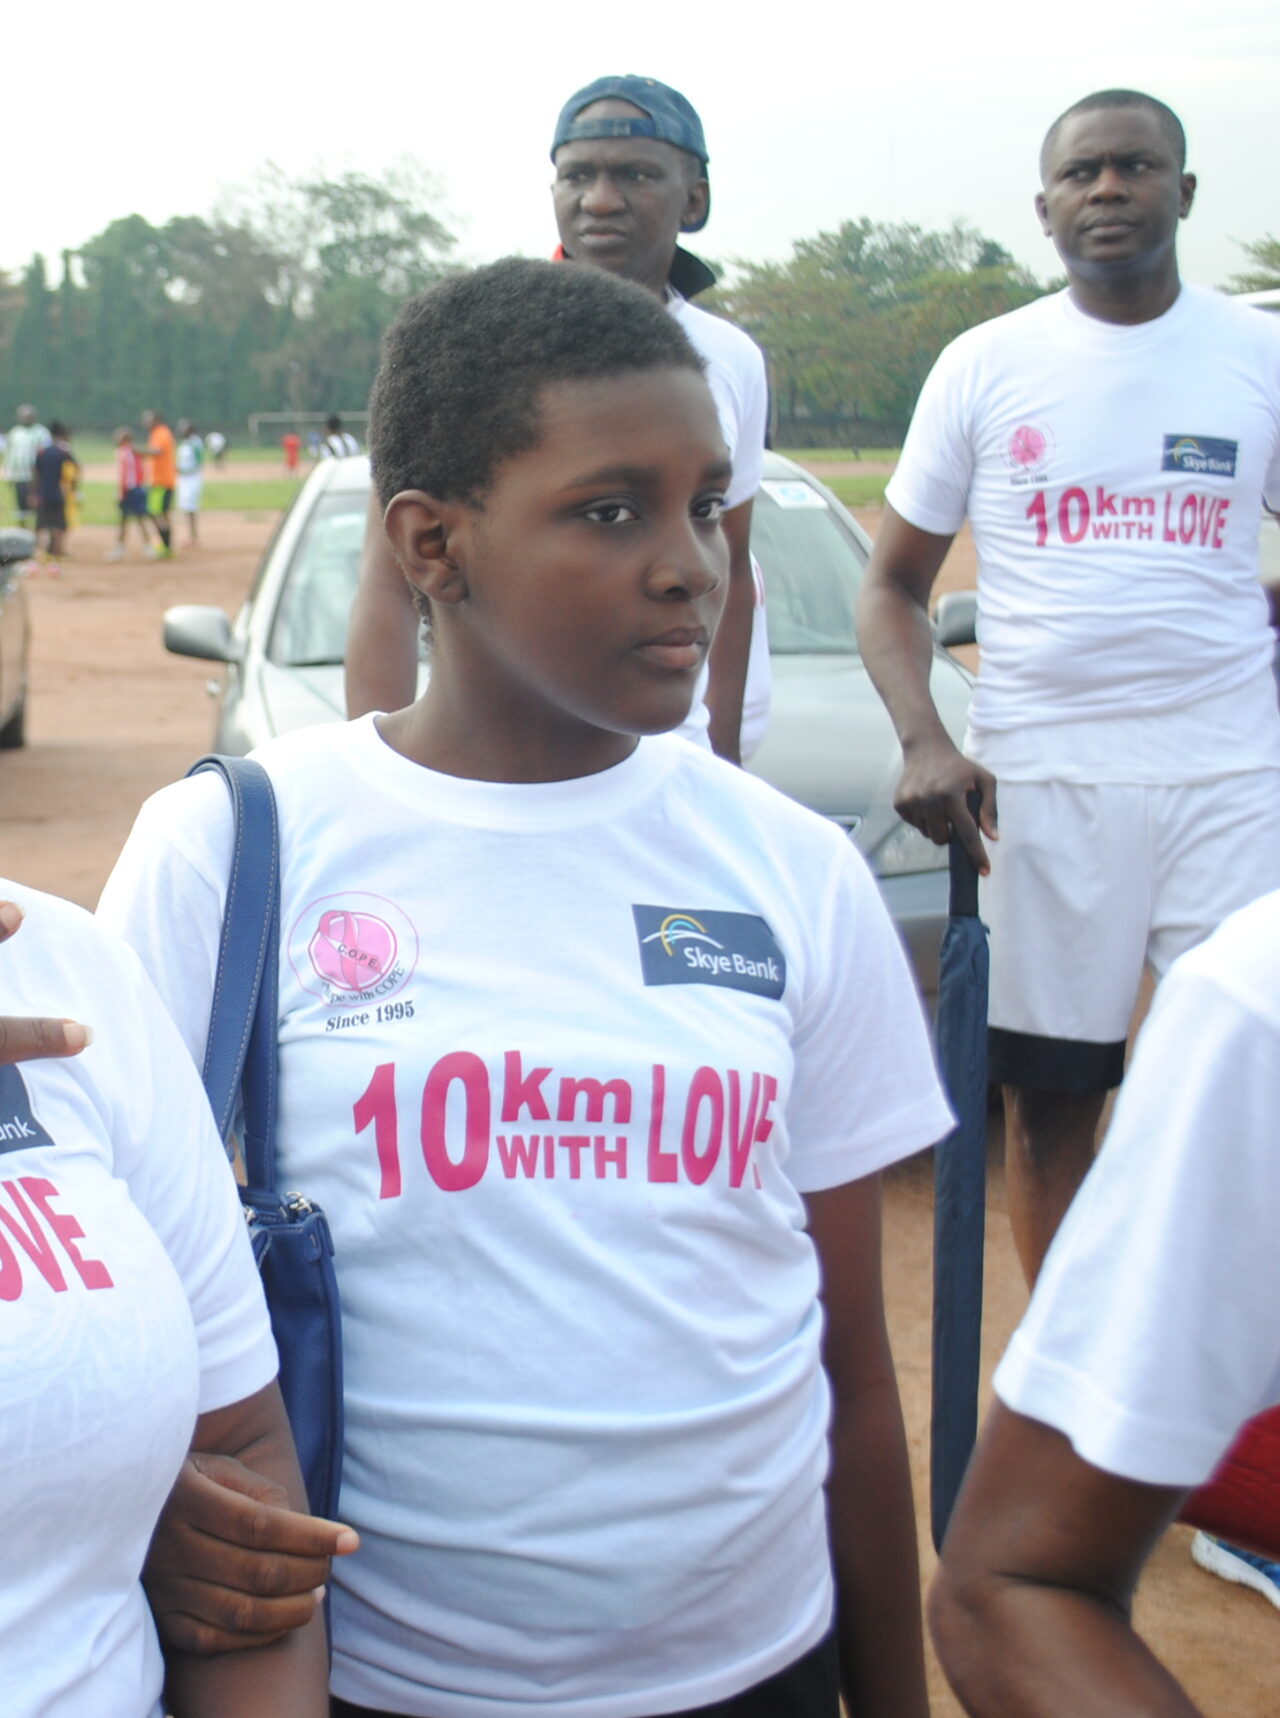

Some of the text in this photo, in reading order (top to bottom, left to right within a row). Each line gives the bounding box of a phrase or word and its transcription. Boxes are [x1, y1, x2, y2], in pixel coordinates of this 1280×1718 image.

[1026, 485, 1231, 549] 10 km WITH LOVE
[684, 946, 779, 982] Skye Bank
[325, 1000, 415, 1033] Since 1995
[500, 1050, 632, 1124] km
[352, 1050, 491, 1200] 10
[496, 1134, 628, 1180] WITH
